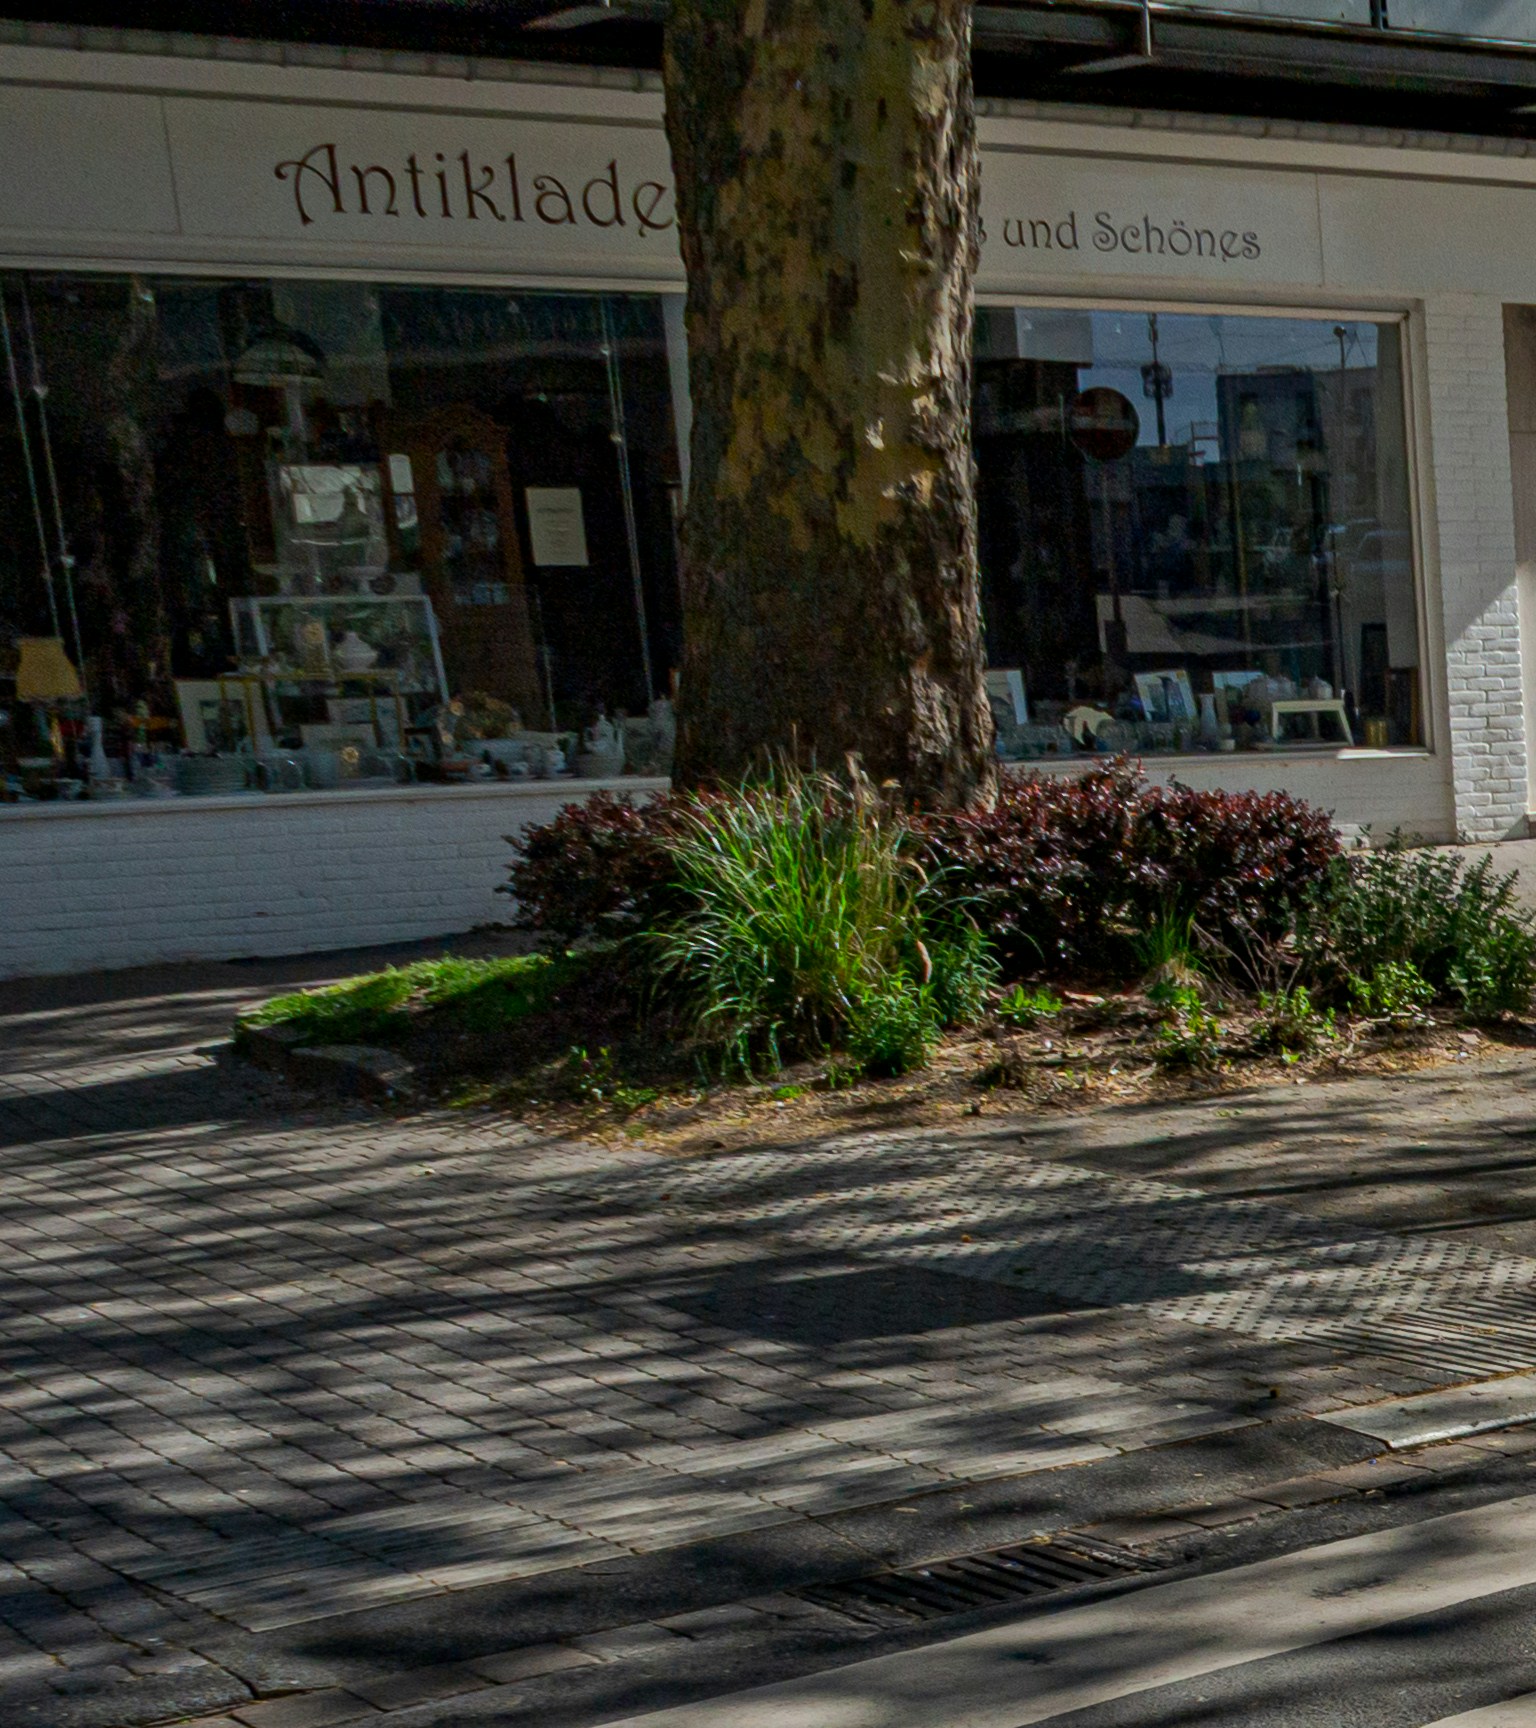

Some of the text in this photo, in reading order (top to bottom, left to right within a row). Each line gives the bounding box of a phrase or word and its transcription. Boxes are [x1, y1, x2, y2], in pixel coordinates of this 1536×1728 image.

[274, 142, 674, 239] Antiklade
[1003, 211, 1079, 250] und
[1092, 211, 1262, 262] Schönes
